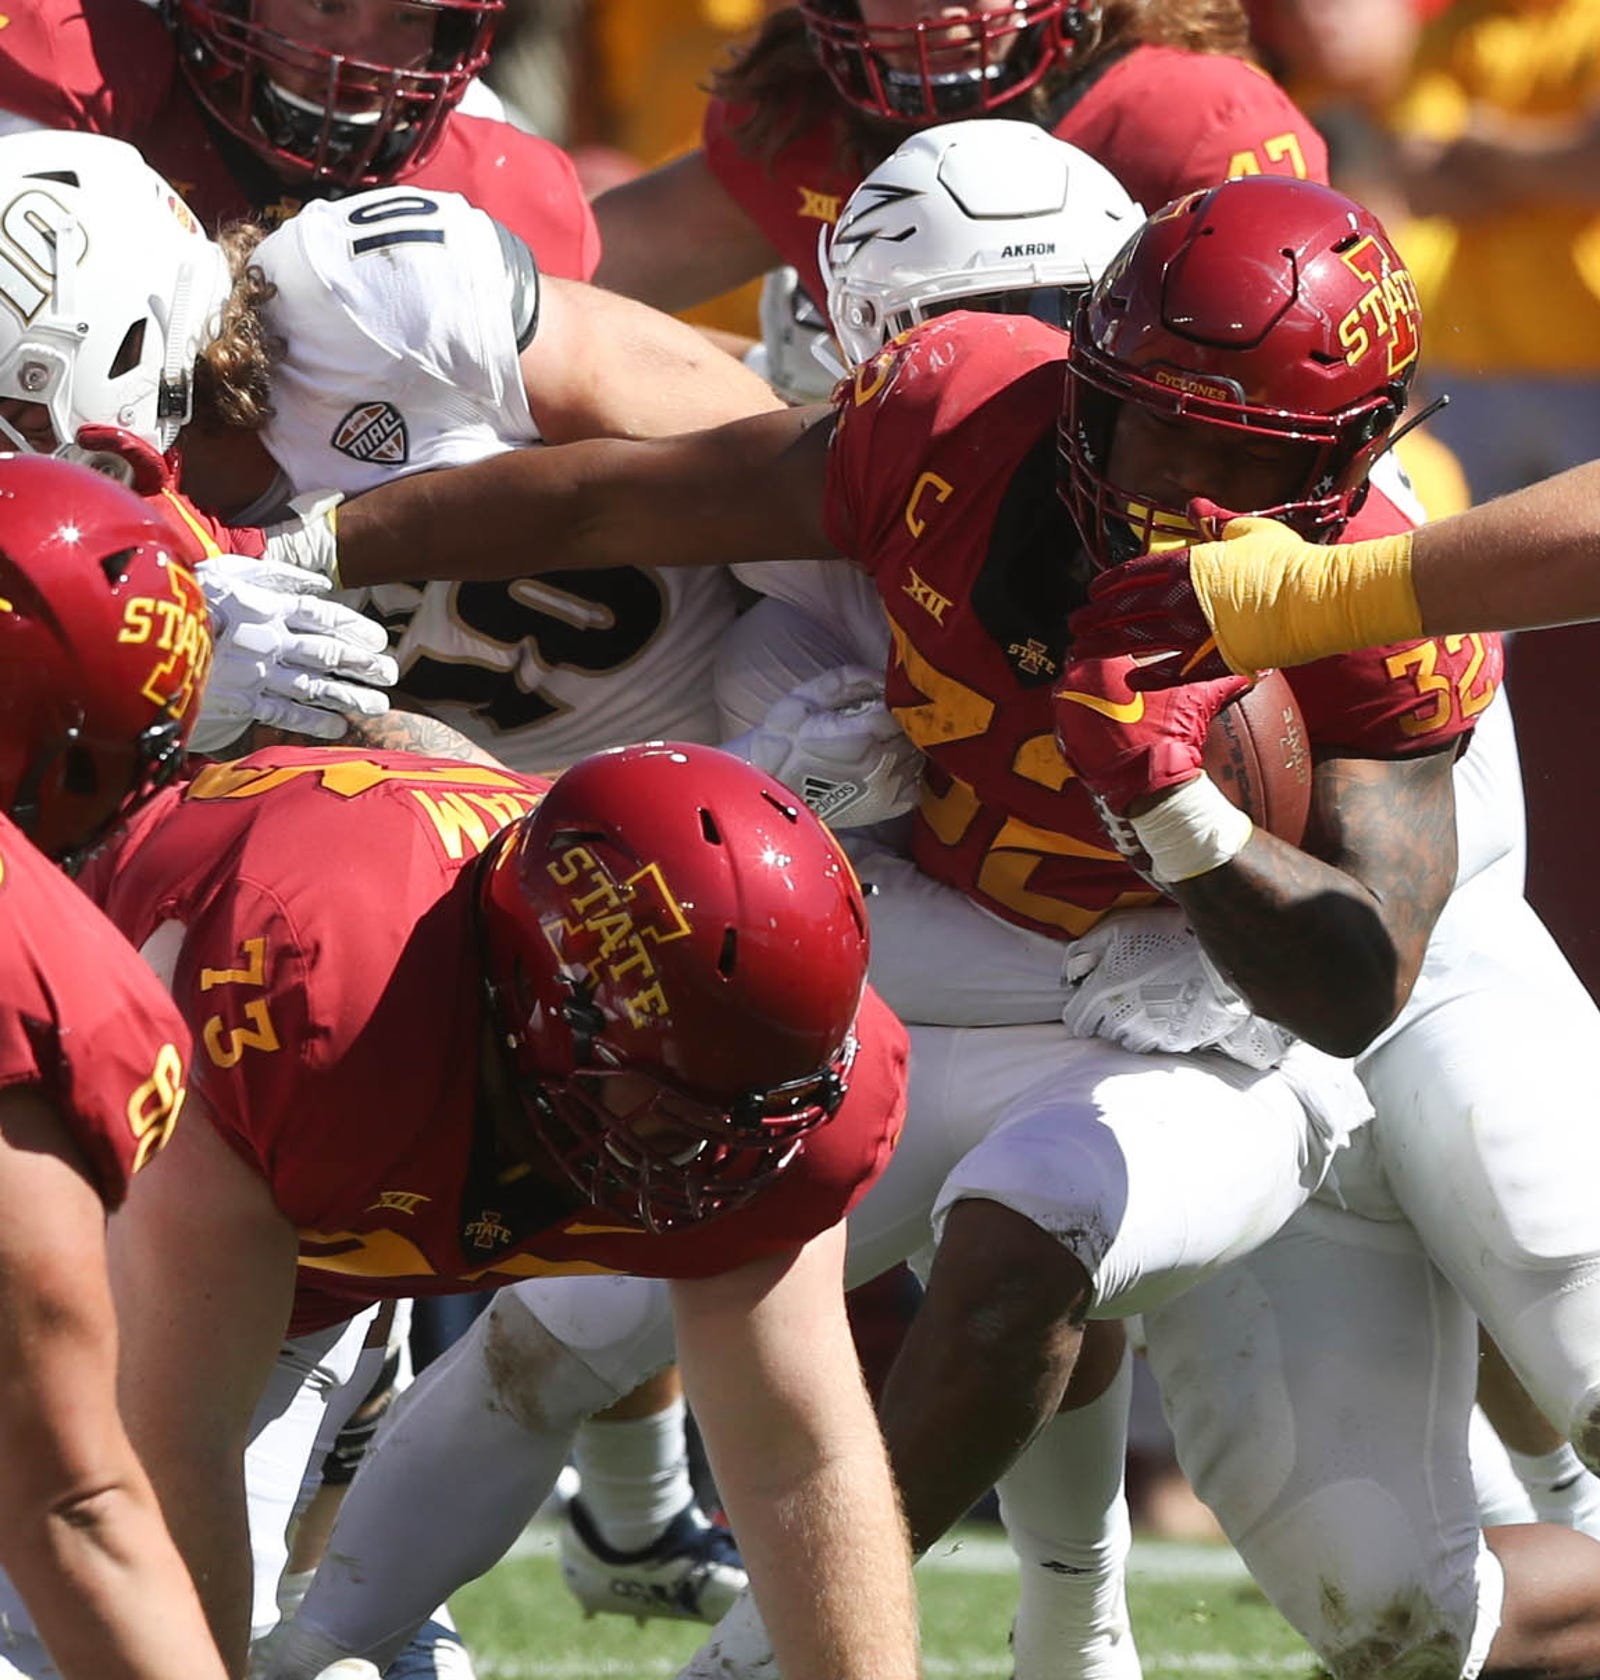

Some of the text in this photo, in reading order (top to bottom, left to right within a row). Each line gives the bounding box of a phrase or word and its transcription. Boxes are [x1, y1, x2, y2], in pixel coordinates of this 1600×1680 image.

[347, 196, 446, 257] 10
[1000, 243, 1055, 258] AKRON
[1156, 371, 1227, 400] CYCLONES
[348, 411, 402, 459] MAC
[906, 471, 954, 538] C
[1008, 643, 1056, 675] STATE
[1385, 632, 1495, 737] 32
[816, 784, 856, 812] didas
[547, 847, 669, 1029] STATE
[201, 936, 280, 1068] 73
[464, 1223, 512, 1243] STATE
